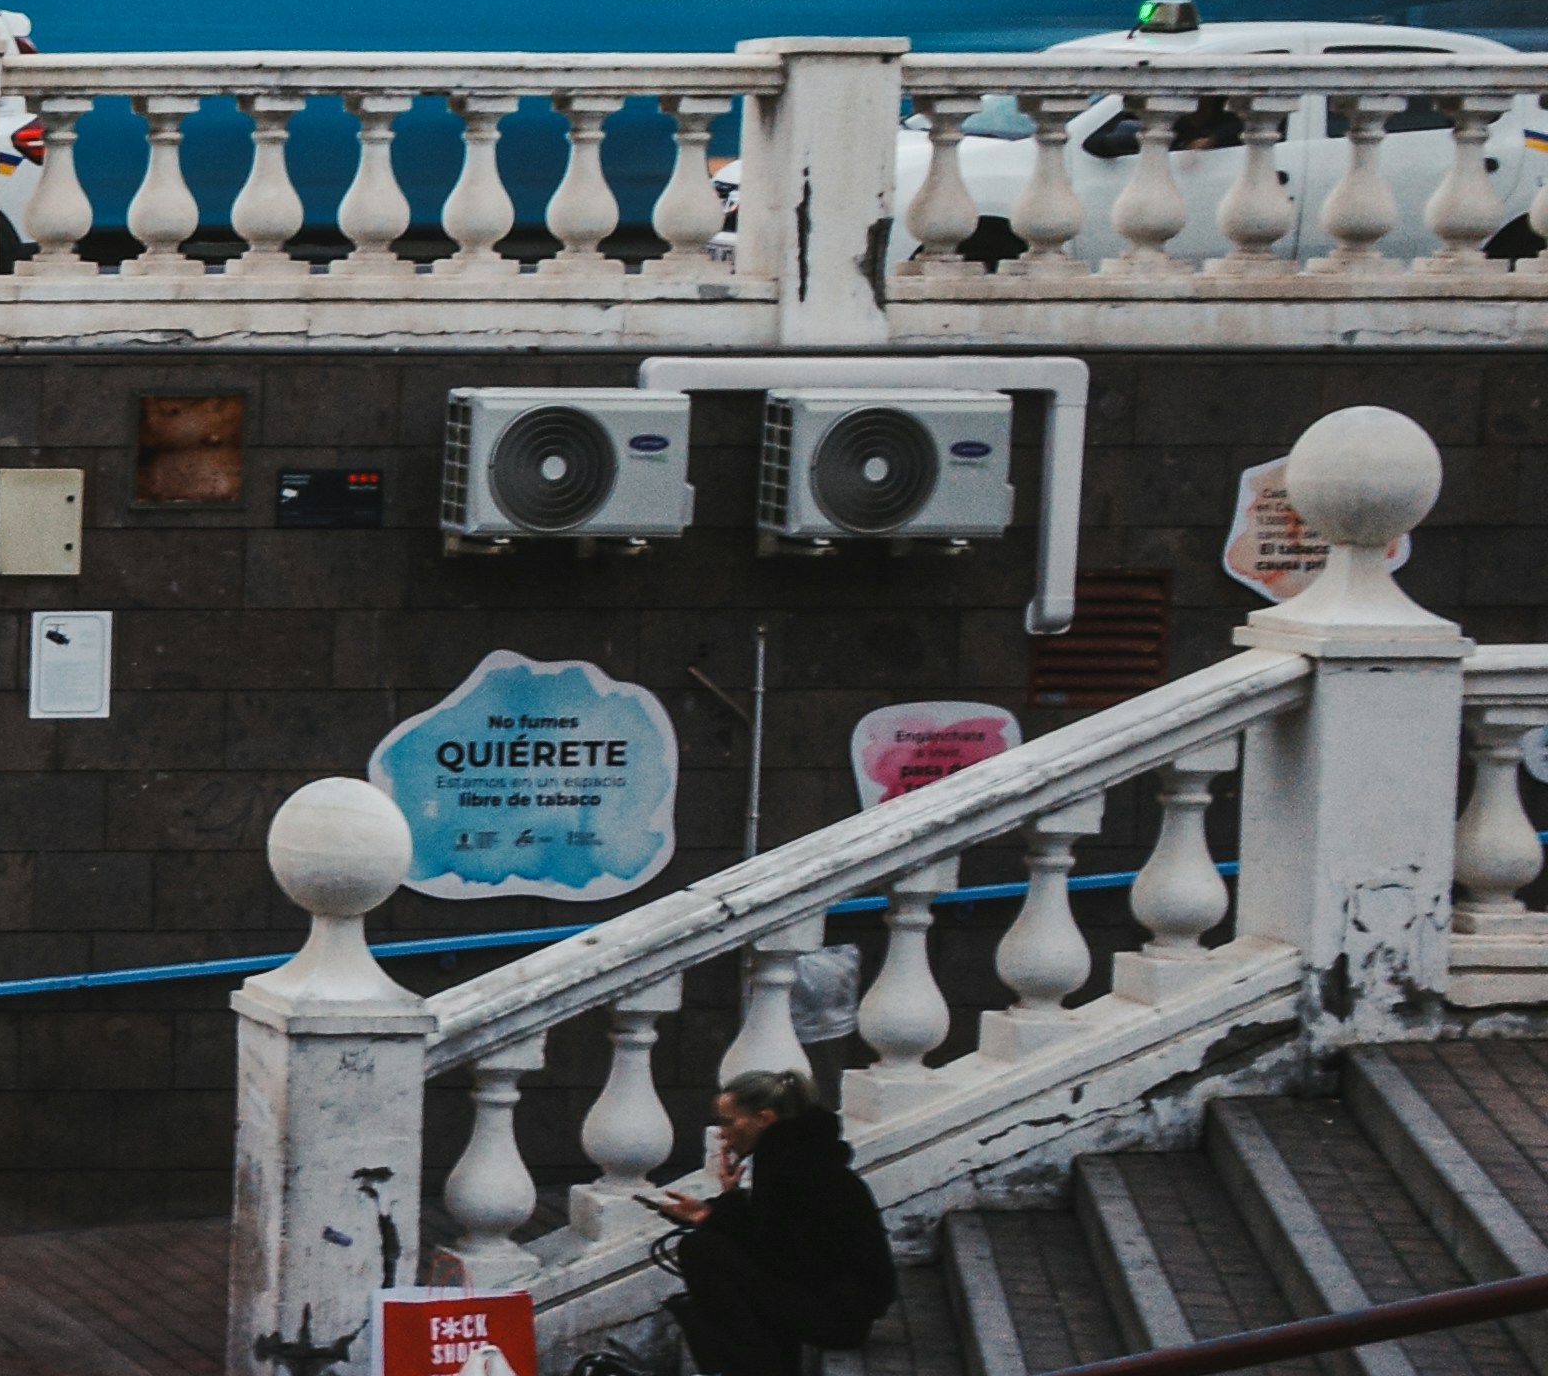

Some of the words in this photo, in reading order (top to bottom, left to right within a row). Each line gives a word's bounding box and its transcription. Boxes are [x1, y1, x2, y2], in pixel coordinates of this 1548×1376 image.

[488, 715, 515, 729] No
[519, 714, 580, 730] fumes
[435, 734, 628, 773] QUIÉRETE
[436, 776, 507, 789] Estamos
[512, 777, 531, 789] en
[537, 777, 558, 789] un
[564, 776, 626, 790] espacio
[459, 792, 502, 807] libre
[507, 792, 531, 807] de
[536, 792, 602, 807] tabaco
